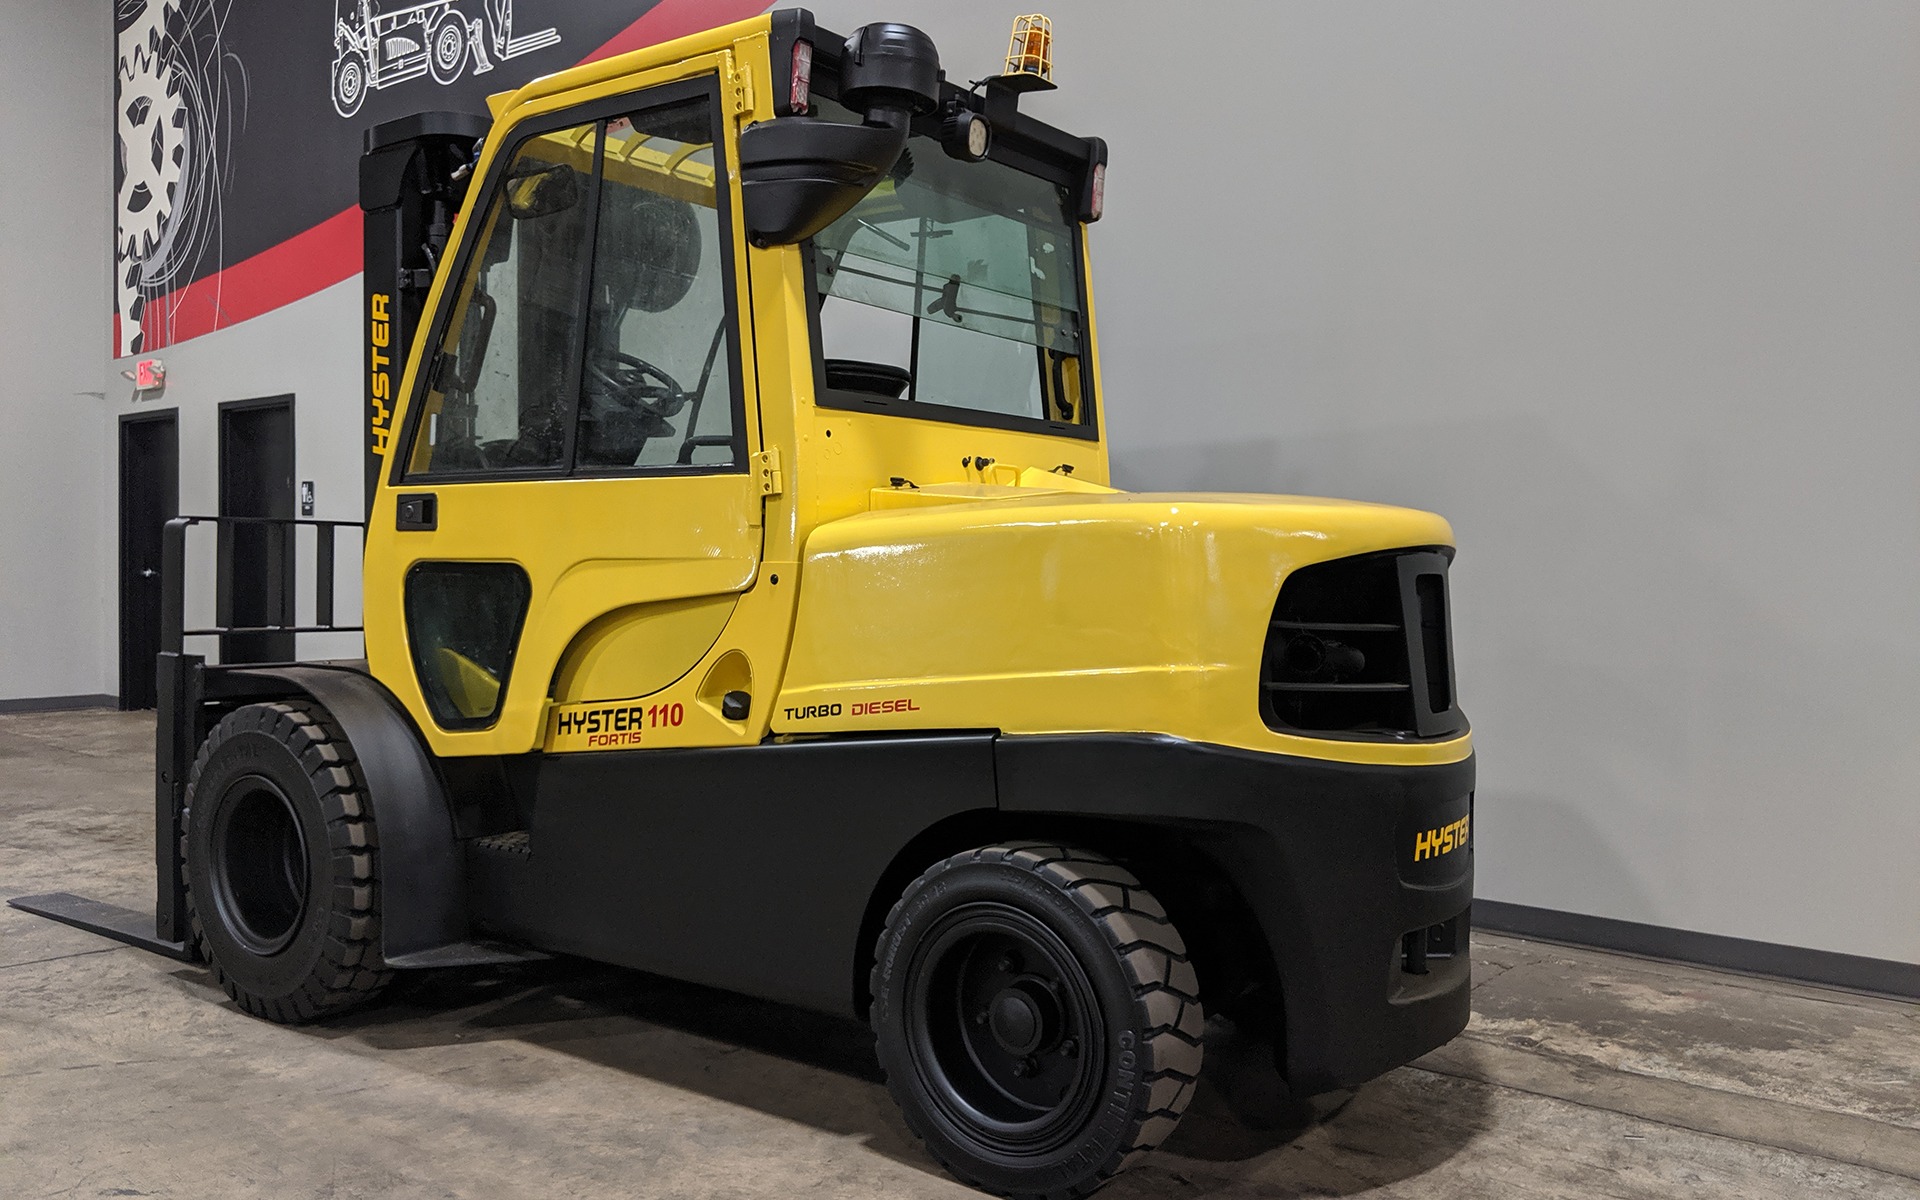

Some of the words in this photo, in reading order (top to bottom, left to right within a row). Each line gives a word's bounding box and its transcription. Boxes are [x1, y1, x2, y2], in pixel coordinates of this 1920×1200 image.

[372, 293, 390, 456] HYSTER
[557, 707, 643, 735] HYSTER
[648, 703, 684, 728] 110
[784, 704, 842, 720] TURBO
[851, 699, 920, 716] DIESEL
[588, 732, 642, 747] FORTIS
